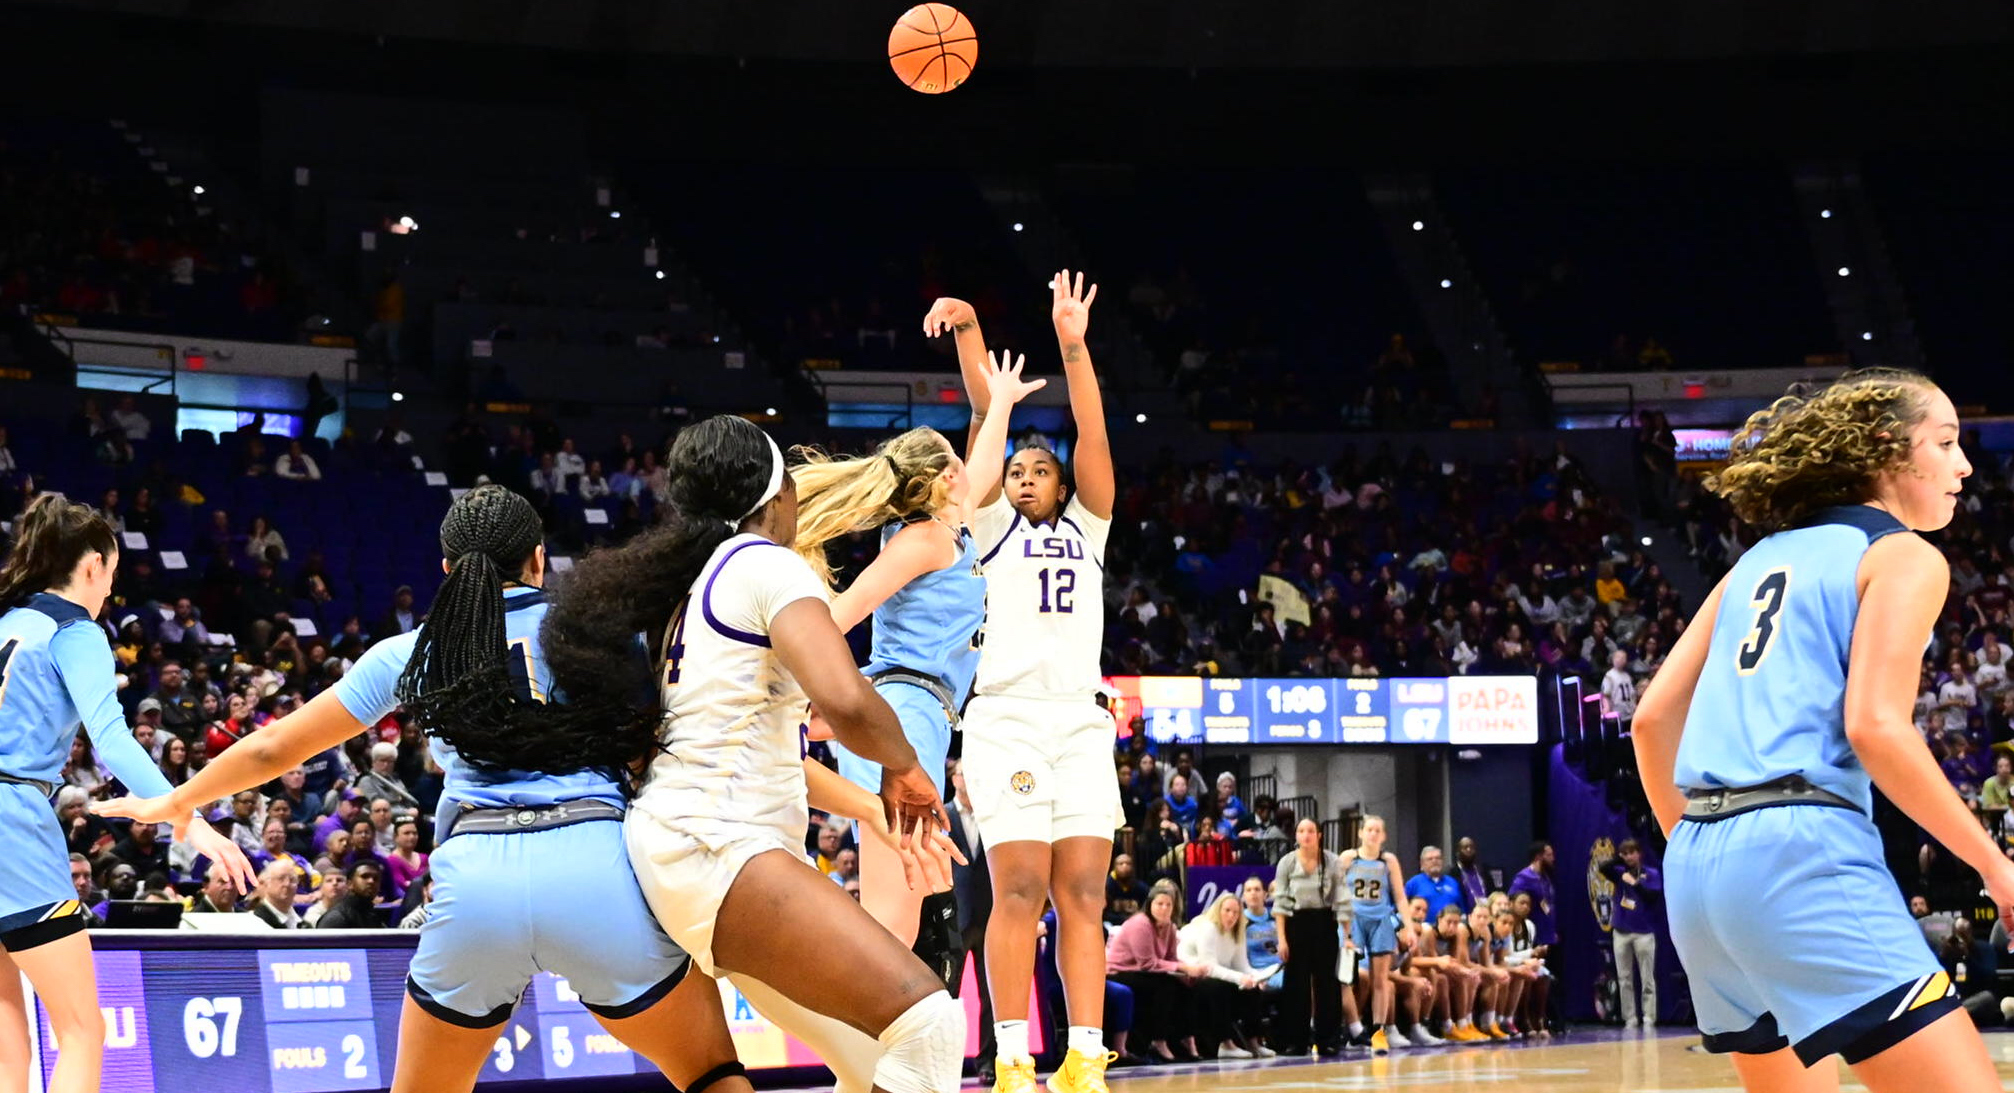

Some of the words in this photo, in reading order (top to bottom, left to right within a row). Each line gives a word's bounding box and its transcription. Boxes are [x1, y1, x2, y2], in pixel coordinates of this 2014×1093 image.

[1023, 538, 1084, 560] LSU
[1038, 568, 1076, 614] 12
[1735, 565, 1792, 677] 3
[1356, 692, 1371, 714] 2
[1458, 689, 1527, 711] PAPA
[1404, 708, 1443, 740] 67
[1458, 717, 1528, 732] JOHNS
[1354, 878, 1381, 899] 22
[271, 962, 352, 983] TIMEOUTS
[183, 996, 243, 1058] 67
[273, 1046, 327, 1069] FOULS
[341, 1034, 368, 1079] 2
[493, 1036, 515, 1073] 3
[551, 1026, 574, 1068] 5
